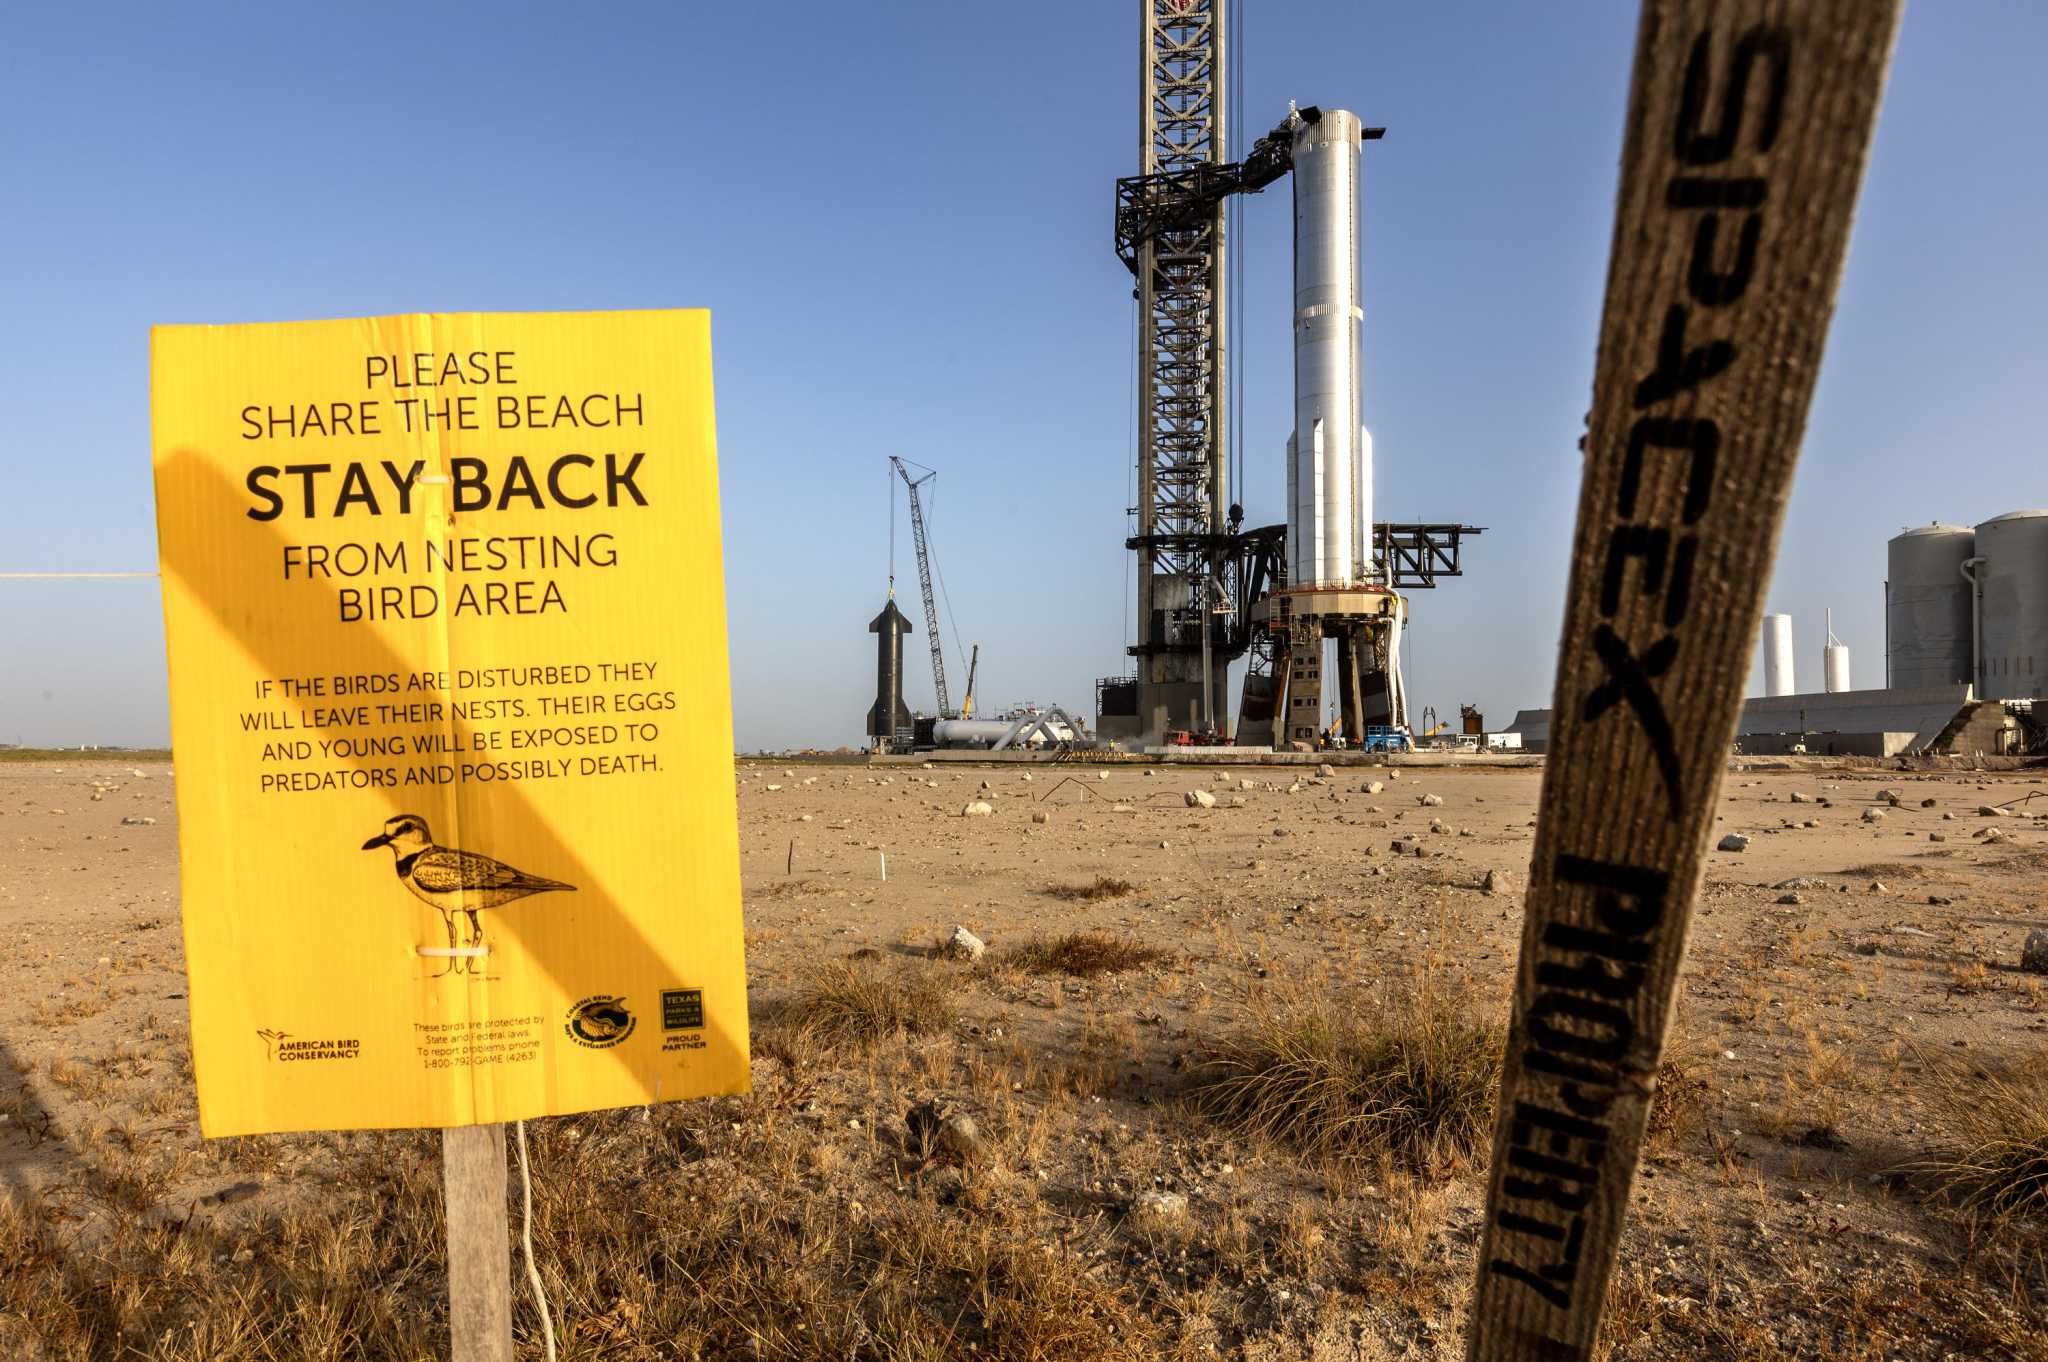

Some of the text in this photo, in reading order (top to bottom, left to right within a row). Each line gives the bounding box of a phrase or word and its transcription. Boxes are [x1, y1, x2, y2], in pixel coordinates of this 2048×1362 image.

[366, 351, 517, 389] PLEASE
[241, 393, 644, 439] SHARE THE BEACH
[246, 453, 648, 521] STAY BACK
[283, 534, 617, 580] FROM NESTING
[340, 580, 567, 622] BIRD AREA
[256, 662, 658, 699] IF THE BIRDS ARE DISTURBED THEY
[1489, 24, 1794, 1310] SPACEX PROPERTY
[240, 691, 676, 731] WILL LEAVE THEIR NESTS. THEIR EGGS
[262, 723, 658, 761] AND YOUNG WILL BE EXPOSED TO
[261, 754, 663, 792] PREDATORS AND POSSIBLY DEATH.
[666, 995, 699, 1004] TEXAS
[414, 1023, 440, 1032] These
[442, 1022, 464, 1031] birds
[485, 1018, 530, 1029] protected
[534, 1016, 544, 1024] by
[426, 1035, 448, 1044] State
[451, 1034, 469, 1042] and
[666, 1034, 700, 1042] PROUD
[279, 1040, 359, 1051] AMERICAN BIRD
[280, 1050, 359, 1061] CONSERVANCY
[417, 1048, 429, 1056] To
[431, 1048, 459, 1056] report
[662, 1042, 706, 1052] PARTNER
